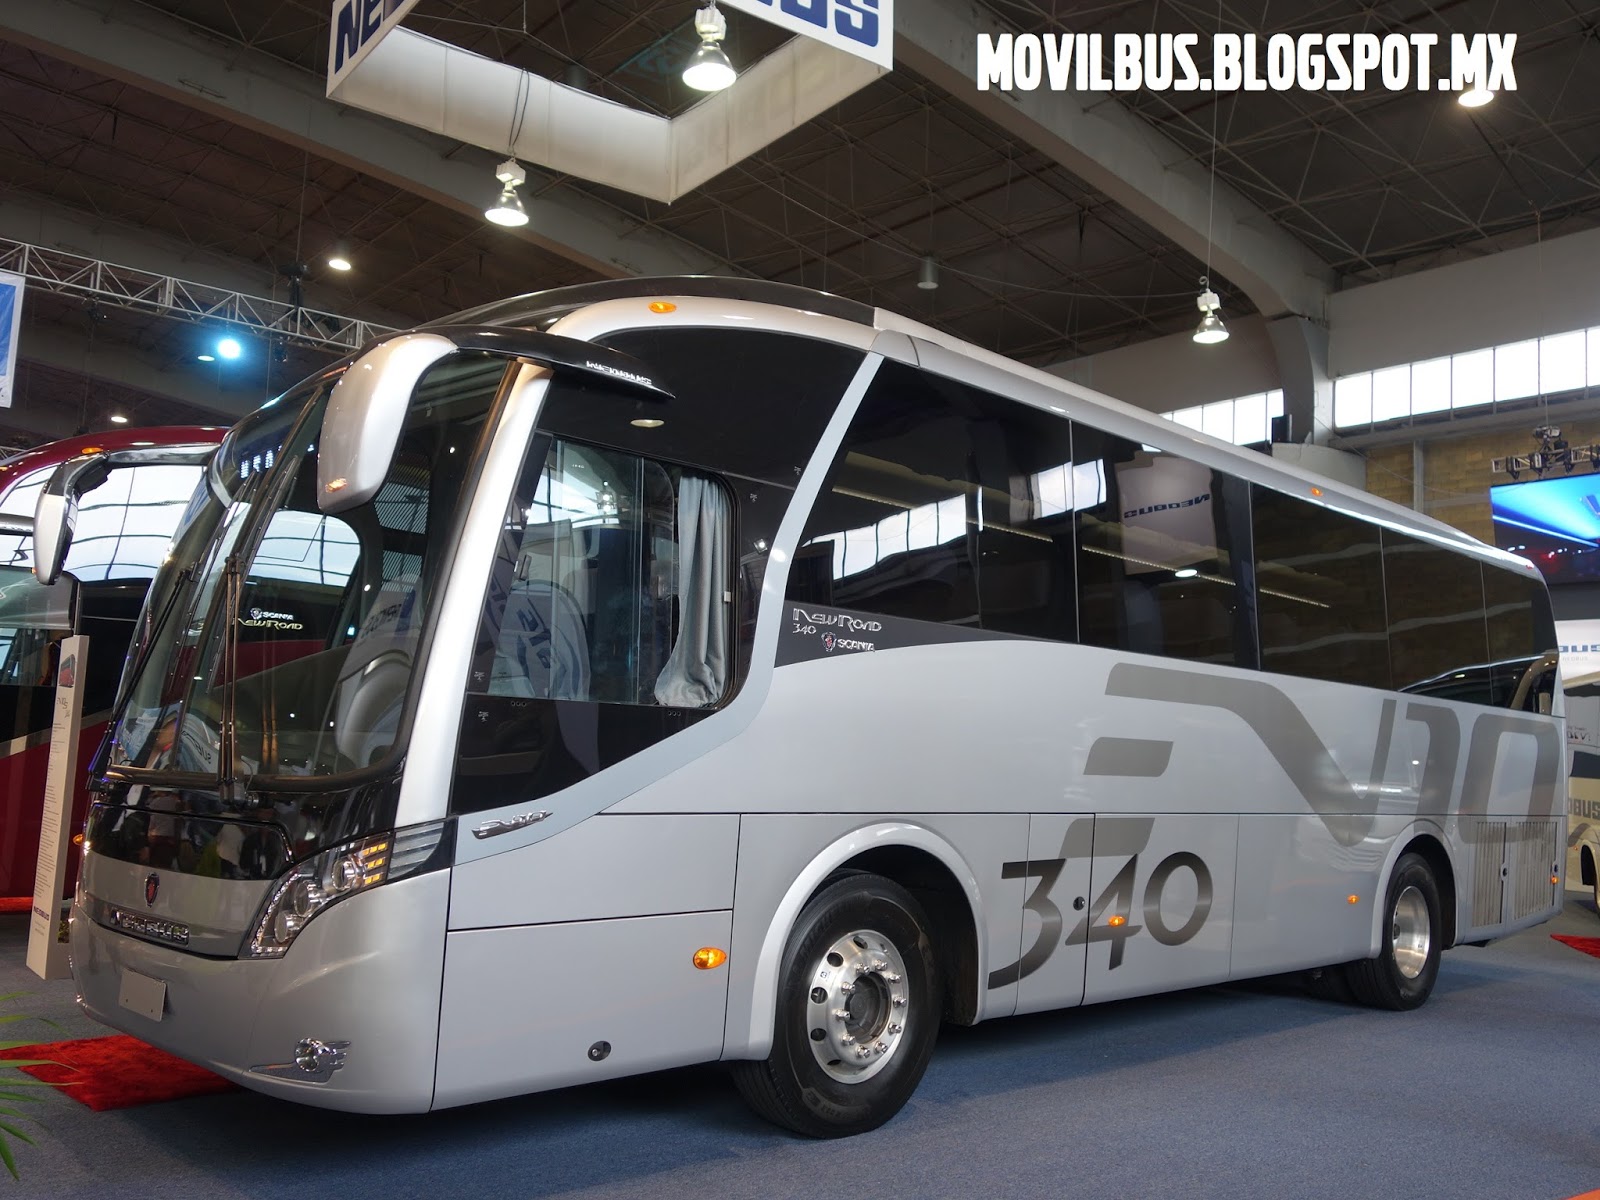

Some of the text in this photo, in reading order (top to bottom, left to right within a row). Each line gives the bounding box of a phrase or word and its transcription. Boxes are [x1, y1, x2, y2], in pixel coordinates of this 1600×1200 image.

[262, 611, 294, 621] SCANIA
[792, 622, 817, 635] 340
[837, 638, 876, 653] SCANIA
[1568, 797, 1600, 821] BUS
[988, 849, 1213, 990] 340
